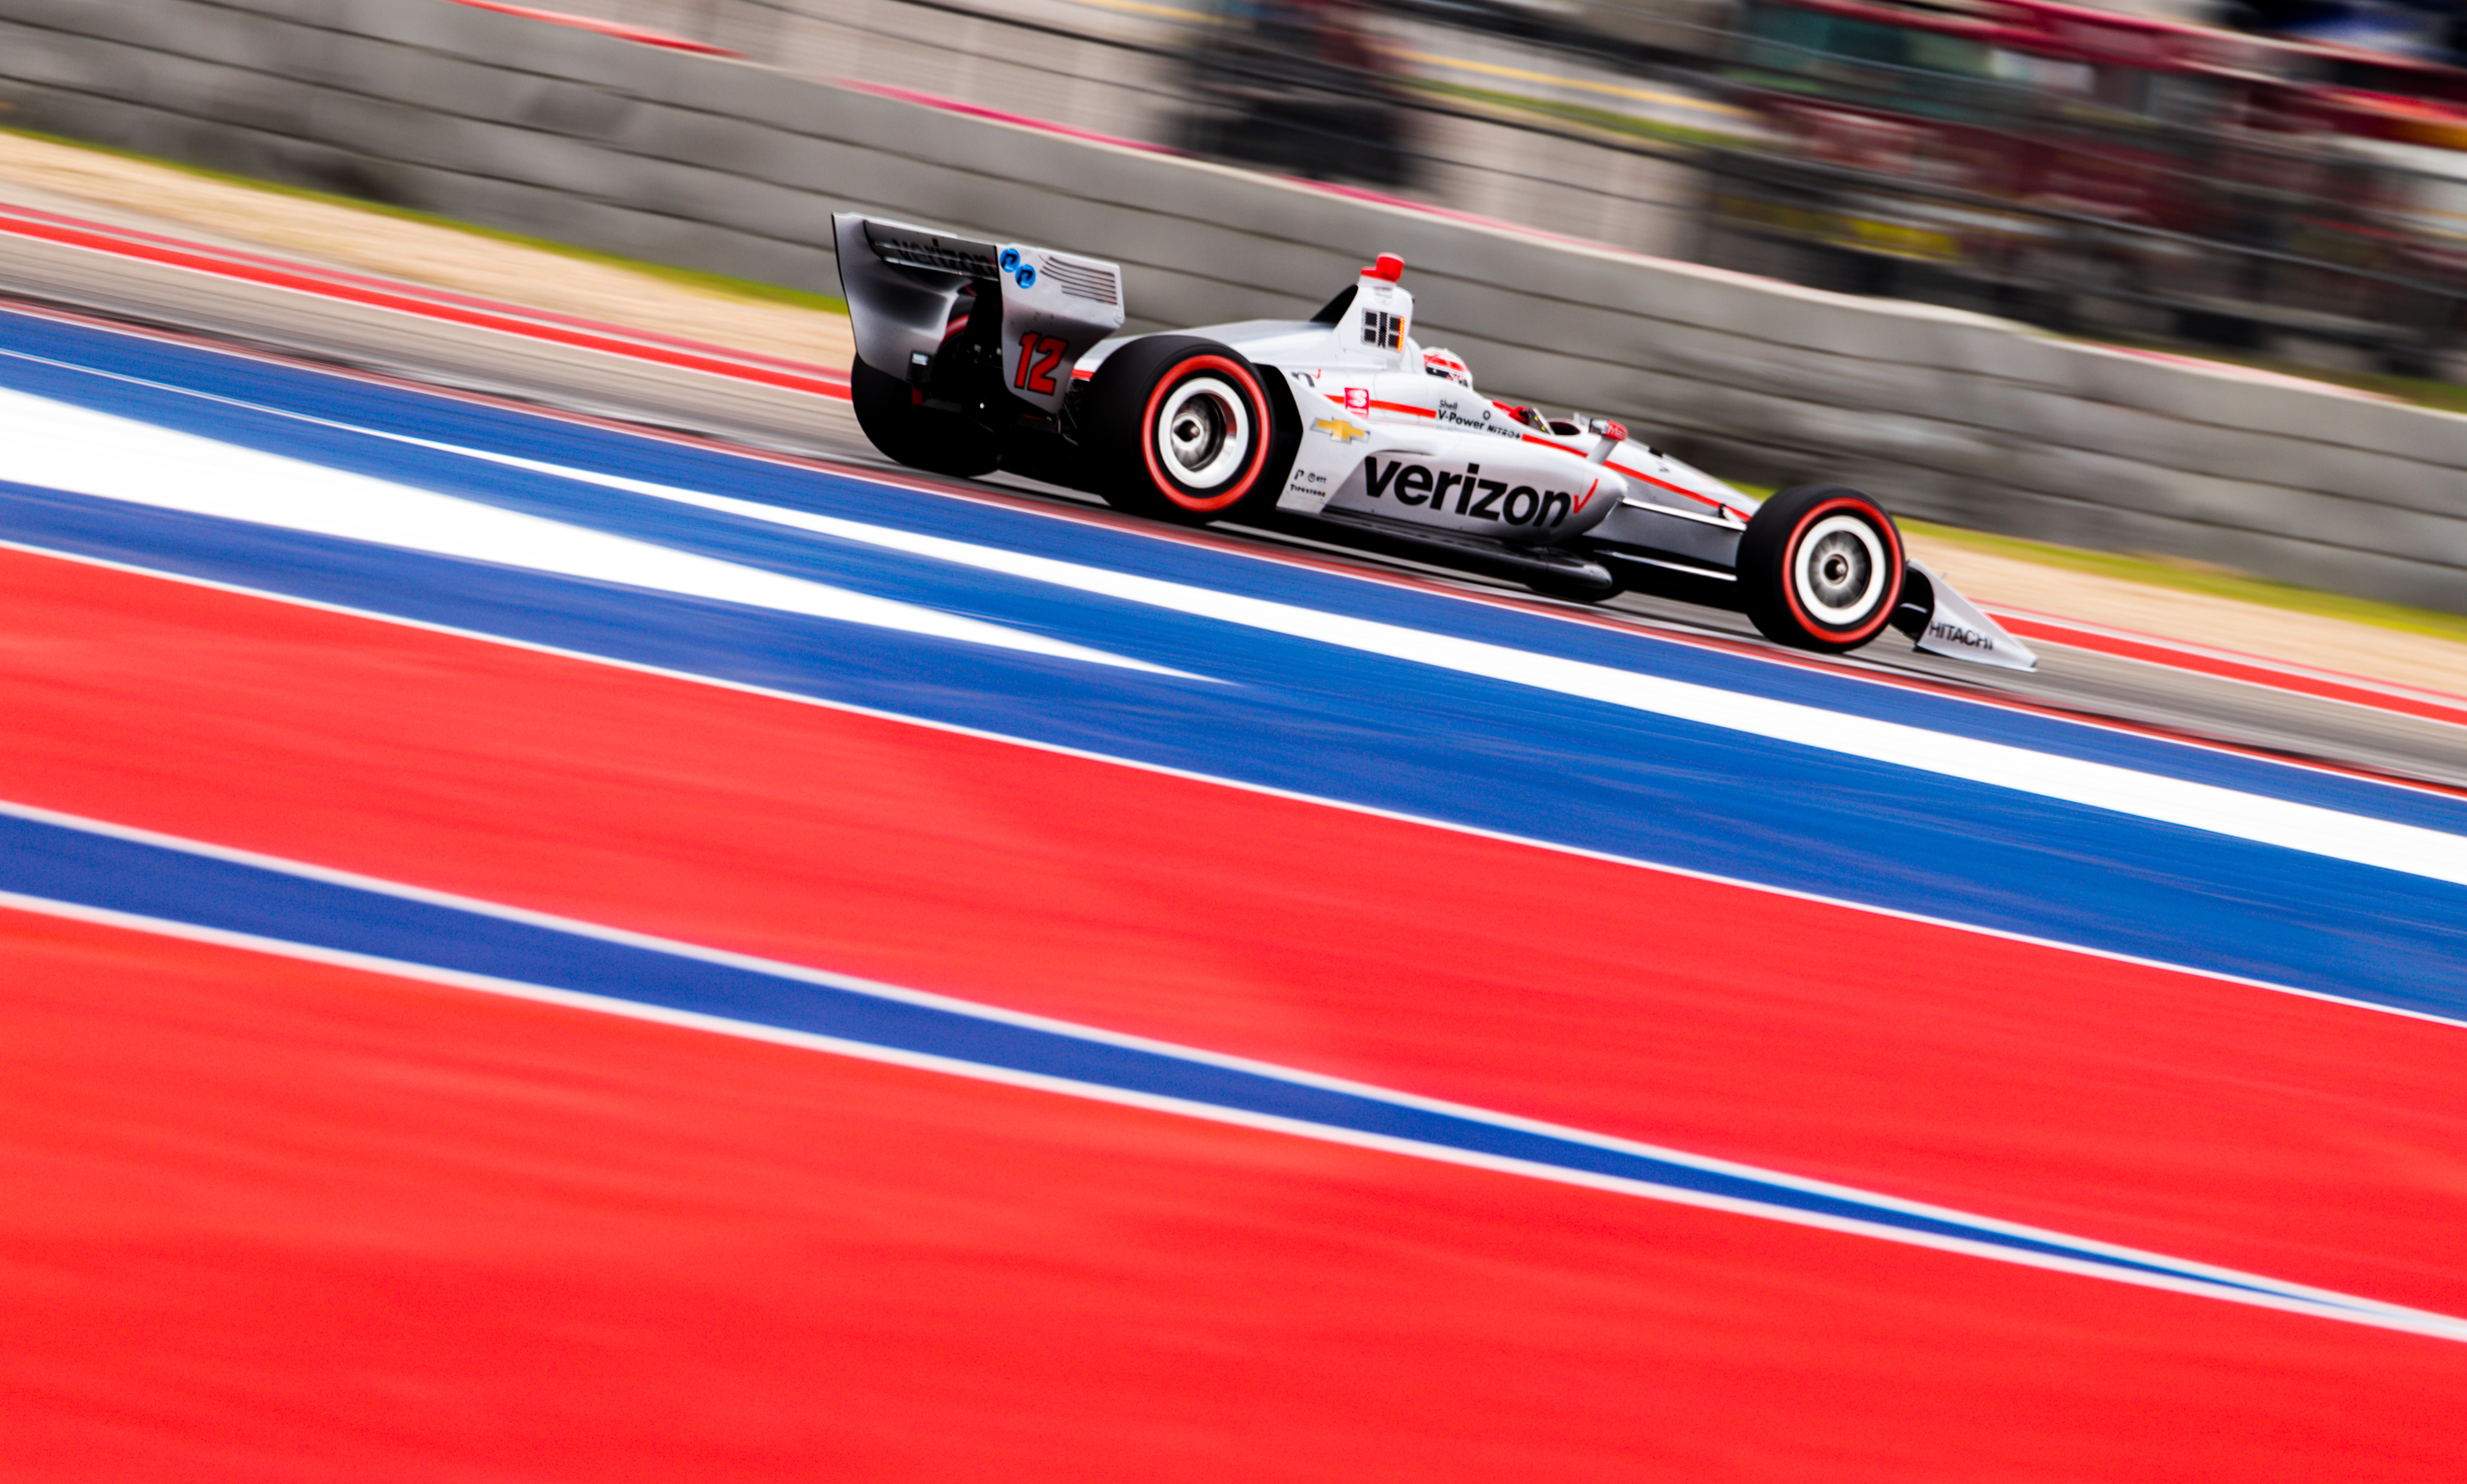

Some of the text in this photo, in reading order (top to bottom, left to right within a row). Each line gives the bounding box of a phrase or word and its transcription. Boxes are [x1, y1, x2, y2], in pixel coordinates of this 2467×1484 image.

[1013, 331, 1070, 396] 12
[1438, 409, 1484, 429] V-Power
[1439, 400, 1458, 410] Shell
[1364, 455, 1572, 528] verizon
[1928, 620, 1993, 651] HITACHI
